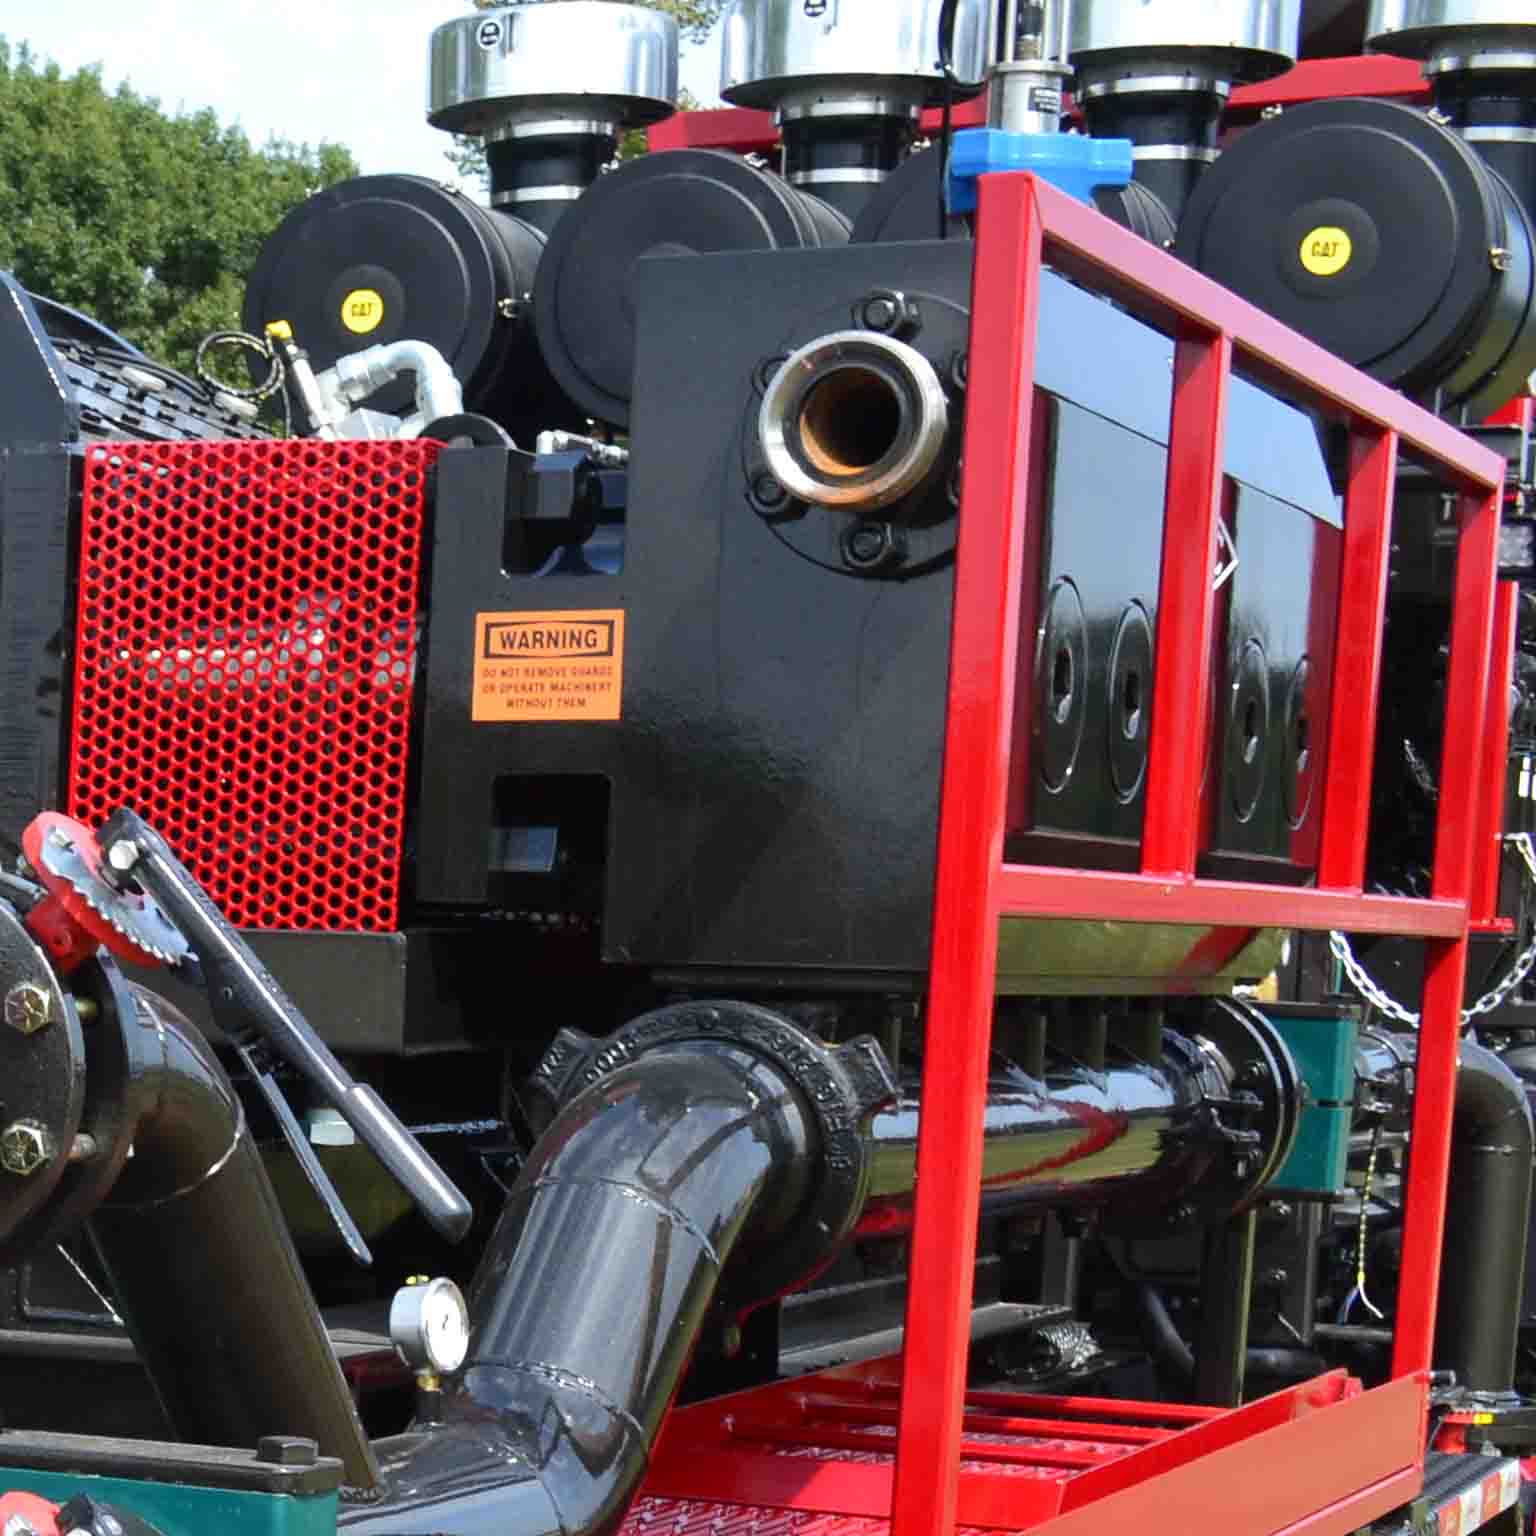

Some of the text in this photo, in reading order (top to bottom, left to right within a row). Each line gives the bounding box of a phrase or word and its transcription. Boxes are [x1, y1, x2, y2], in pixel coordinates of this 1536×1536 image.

[1311, 240, 1339, 257] CAT
[499, 628, 598, 649] WARNING
[482, 667, 497, 678] DO
[501, 667, 520, 678] NOT
[524, 667, 568, 678] REMOVE
[506, 697, 586, 709] WITHOUT THEM
